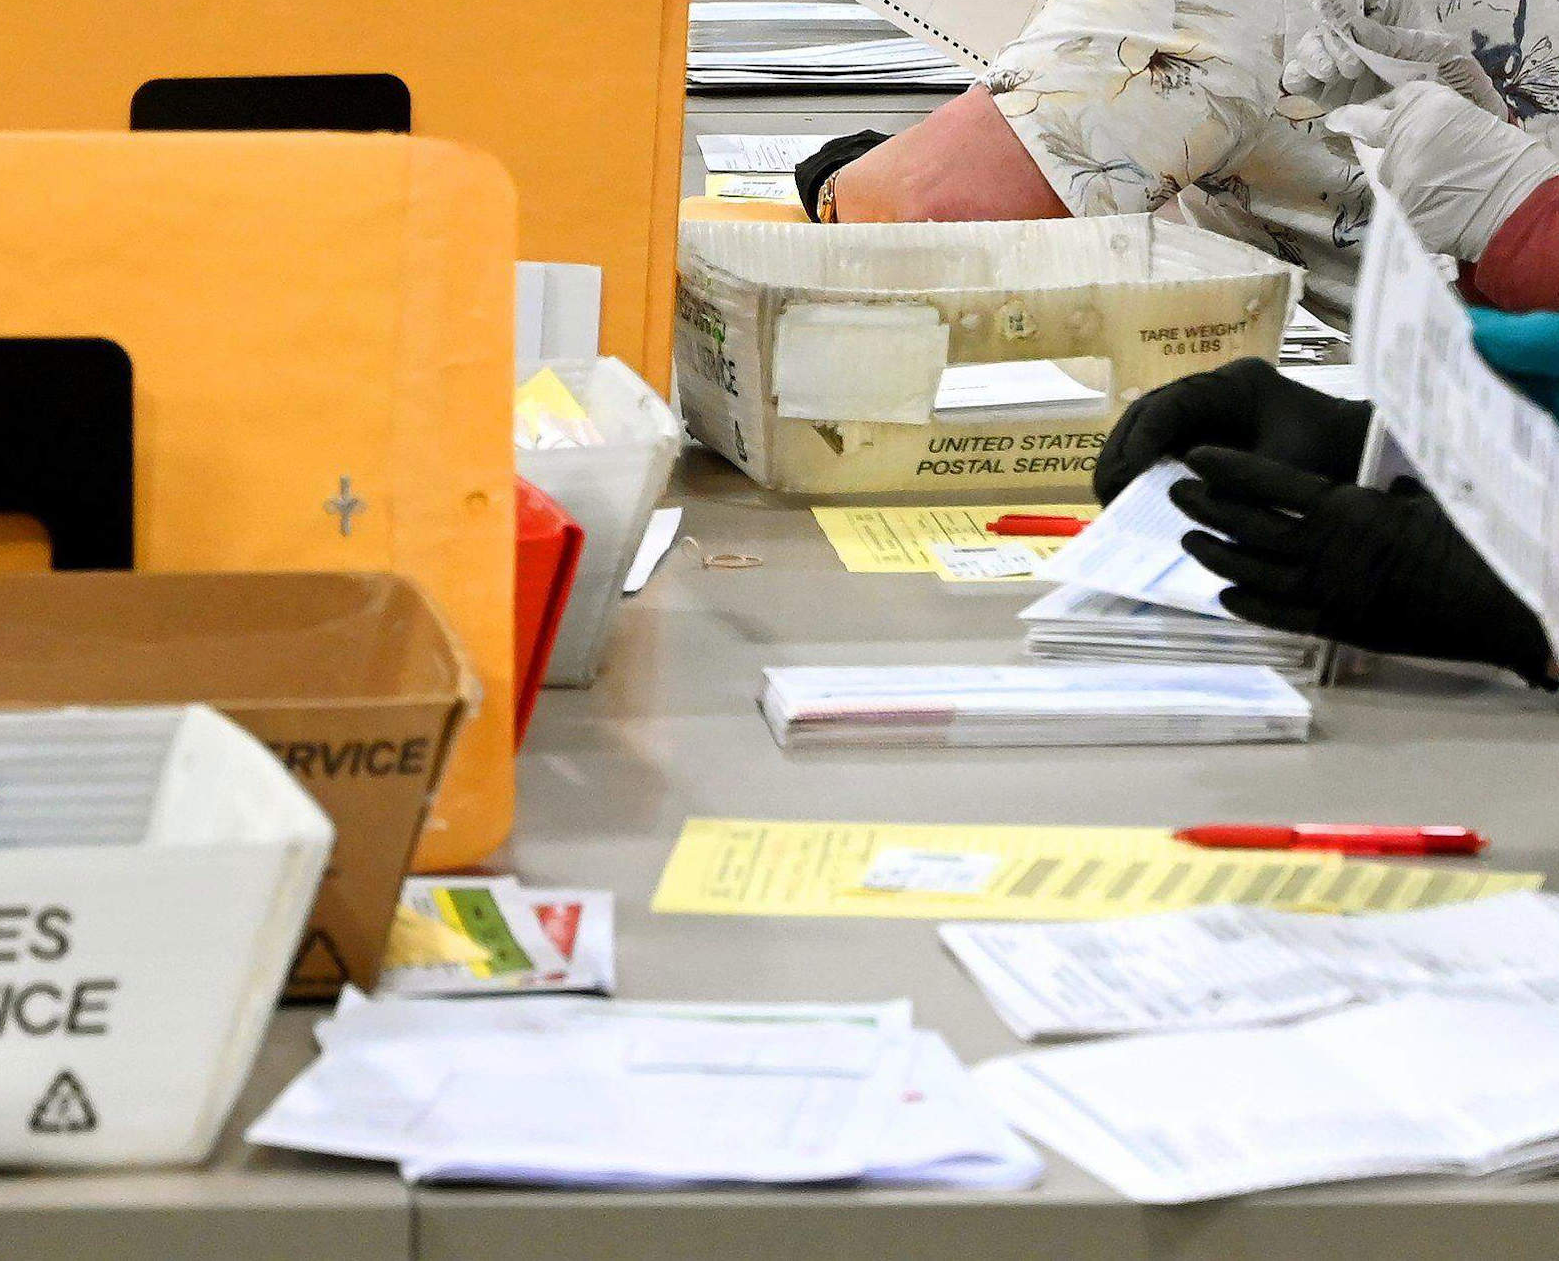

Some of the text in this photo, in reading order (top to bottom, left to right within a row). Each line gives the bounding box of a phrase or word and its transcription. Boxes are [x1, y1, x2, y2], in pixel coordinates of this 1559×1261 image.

[1139, 322, 1248, 342] TARE WEIGHT
[1191, 339, 1221, 354] LBS
[928, 433, 1107, 453] UNITED STATES
[916, 456, 1098, 476] POSTAL SERVIC
